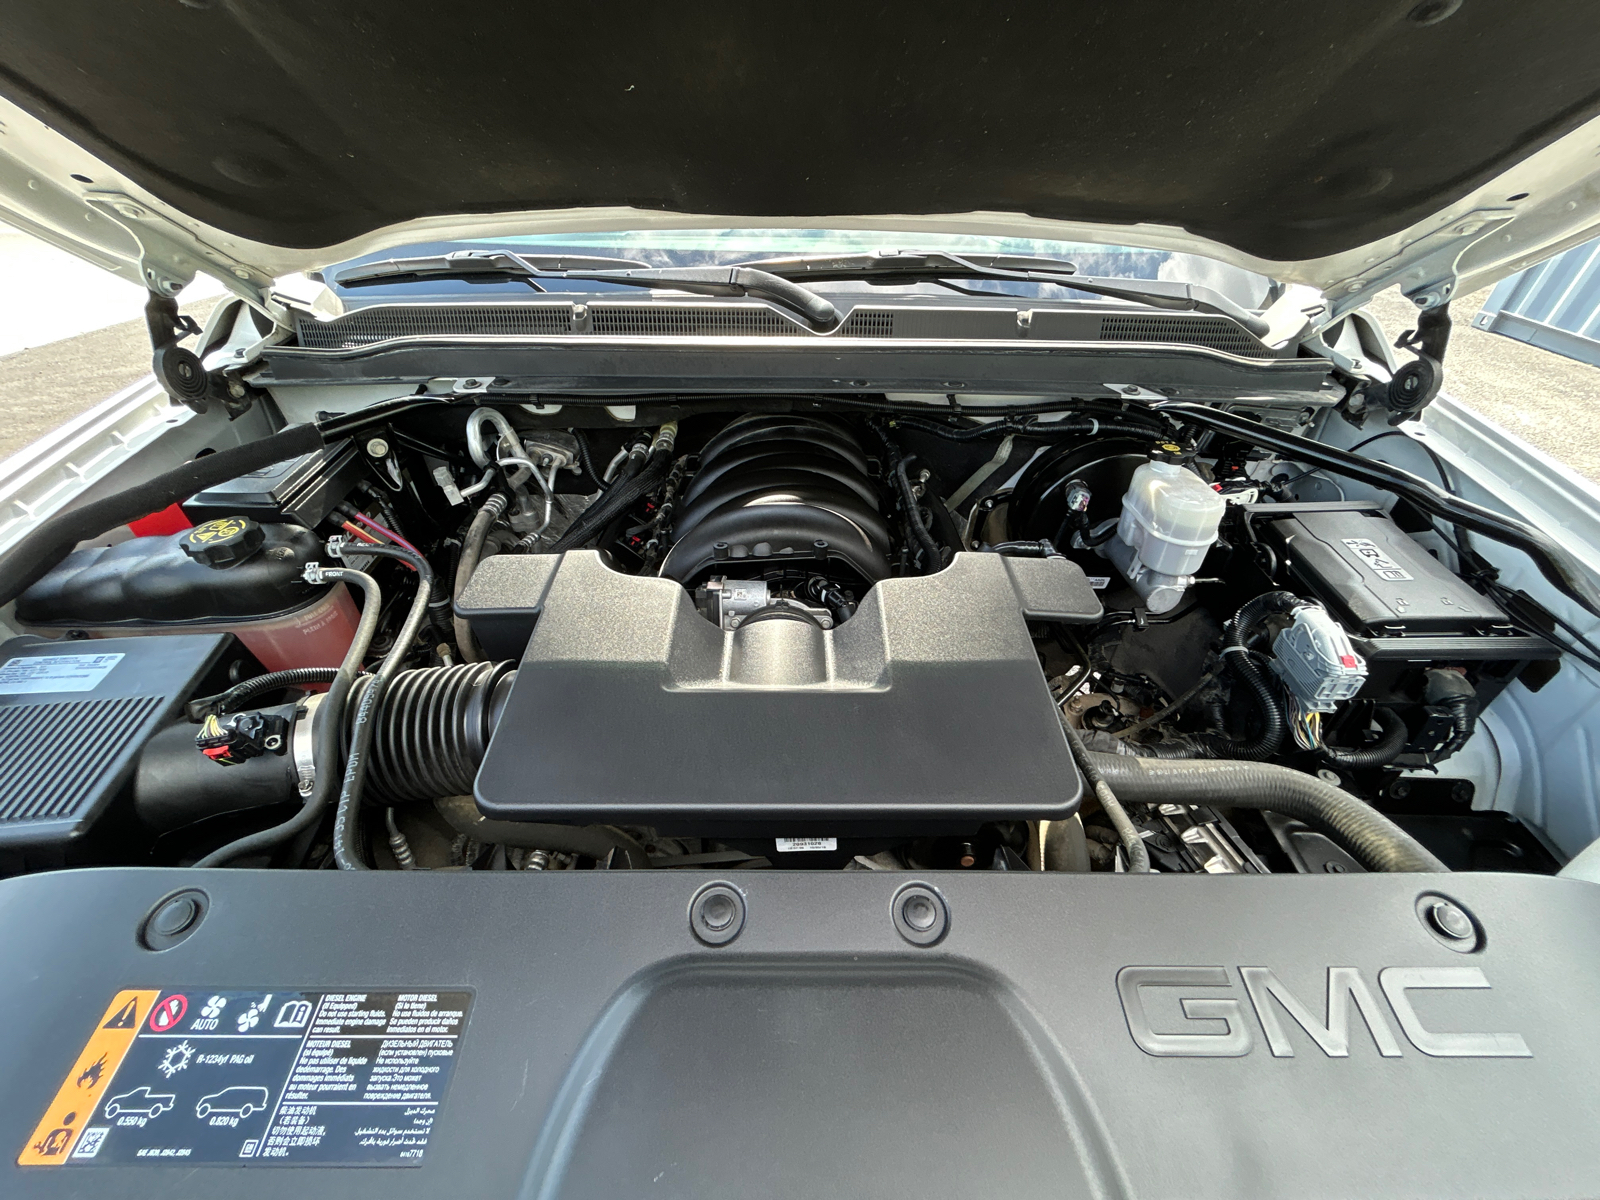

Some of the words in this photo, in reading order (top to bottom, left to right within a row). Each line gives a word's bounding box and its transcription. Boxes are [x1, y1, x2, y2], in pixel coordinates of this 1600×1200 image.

[344, 752, 360, 783] EPDM
[348, 1010, 369, 1018] starting
[1116, 965, 1534, 1057] GMC
[190, 1019, 219, 1030] AUTO
[345, 1018, 364, 1027] engine
[364, 1018, 387, 1027] damage
[397, 1018, 418, 1026] pueden
[418, 1018, 441, 1026] producir
[306, 1040, 332, 1048] MOTEUR
[331, 1040, 351, 1048] DIESEL
[381, 1039, 419, 1048] ДИЗЕЛЬНЫЙ
[418, 1040, 453, 1048] ДВИГАТЕЛЬ
[379, 1049, 395, 1057] (если
[394, 1049, 428, 1057] установлен)
[229, 1054, 245, 1064] PAG
[244, 1054, 254, 1064] oil
[348, 1057, 368, 1066] liquide
[385, 1057, 419, 1065] используйте
[292, 1074, 324, 1083] dommages
[318, 1083, 349, 1092] pourraient
[279, 1106, 317, 1115] 柴油发动机
[117, 1116, 137, 1126] 0.550
[137, 1116, 148, 1128] kg
[229, 1116, 239, 1128] kg
[267, 1136, 321, 1146] 否则会立即损坏
